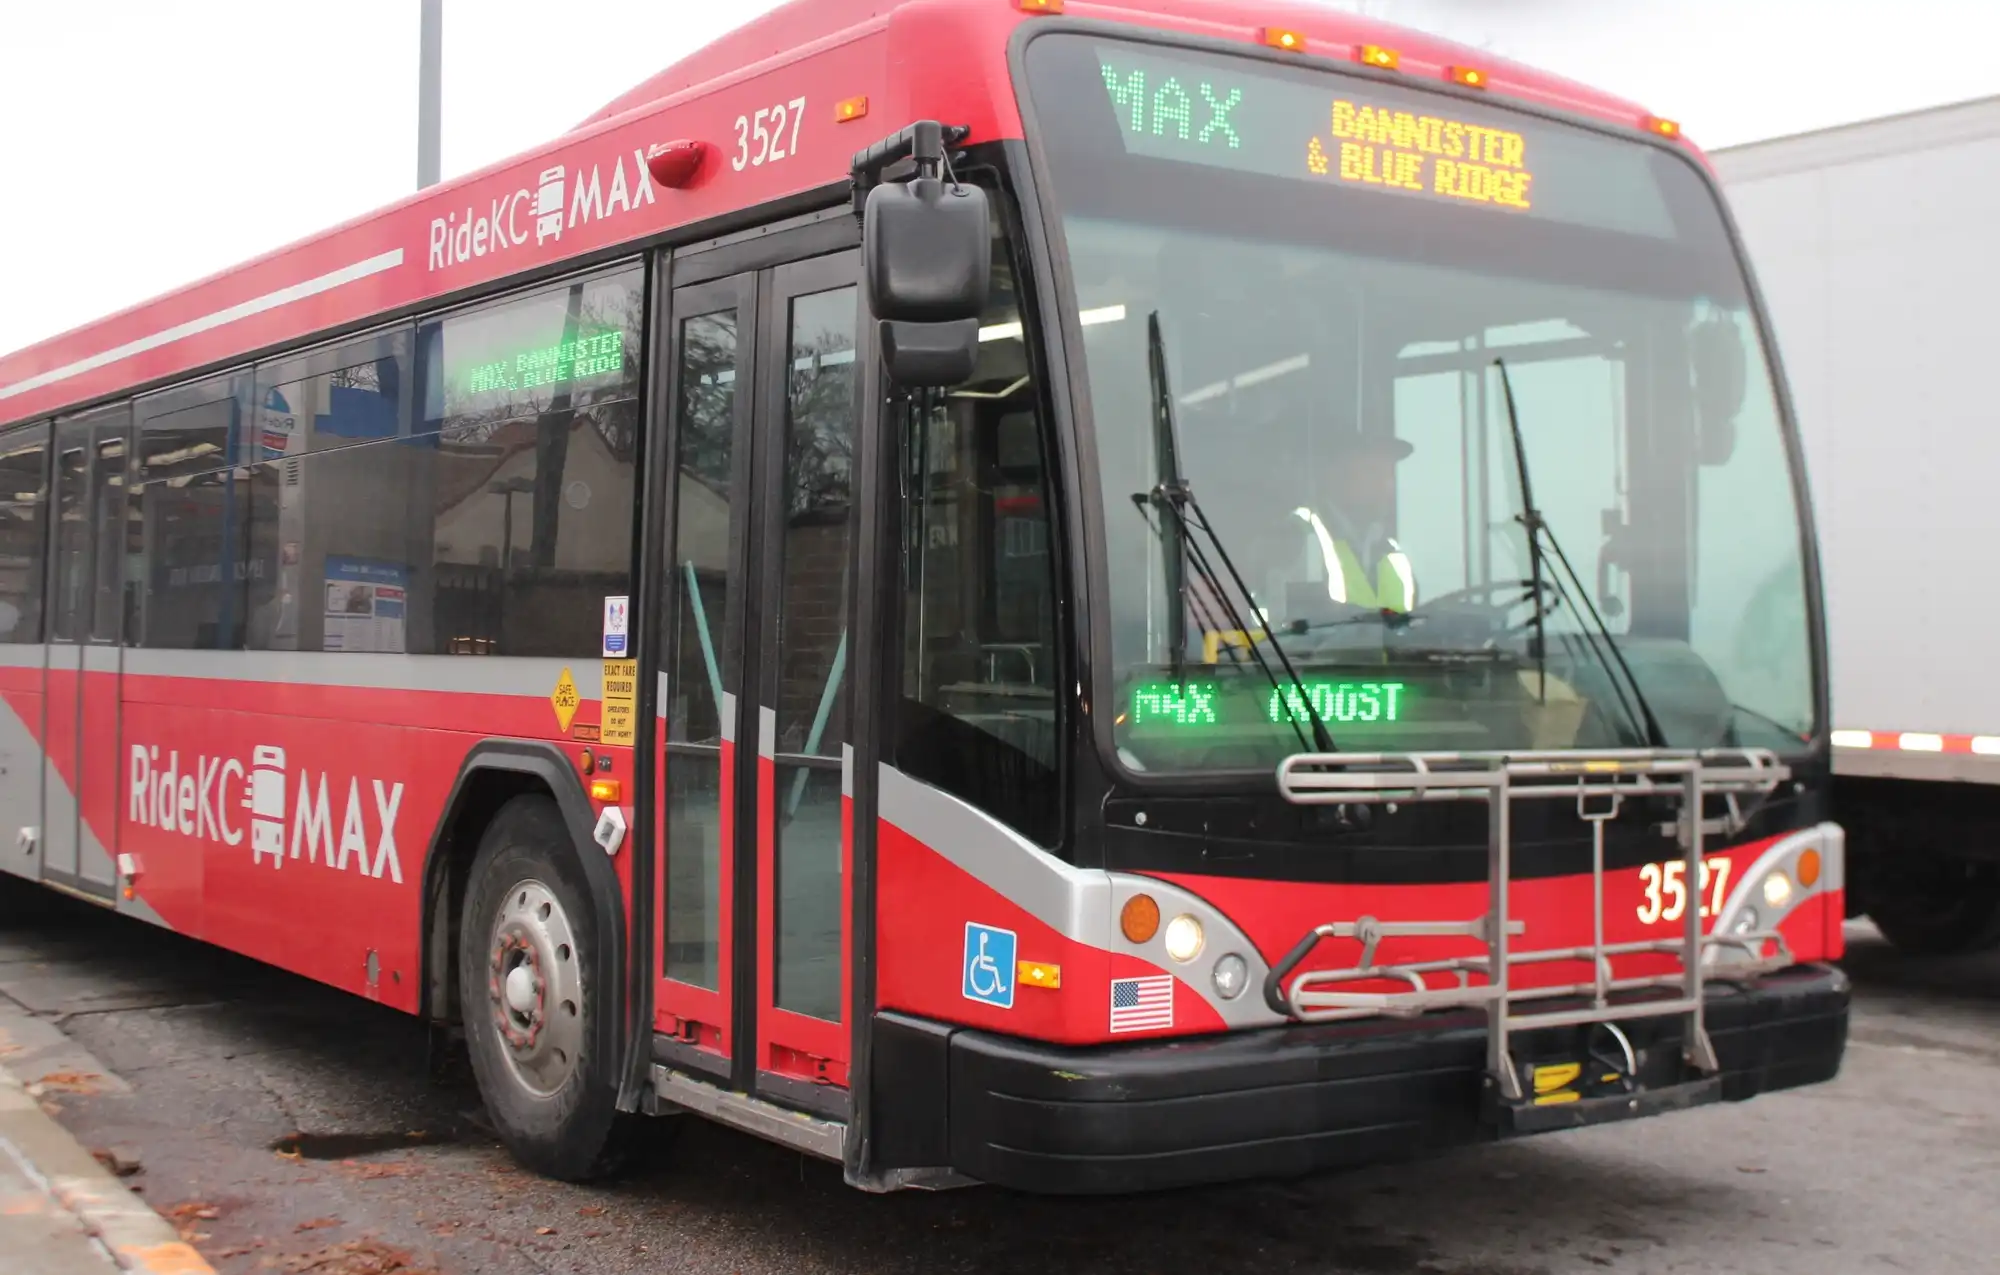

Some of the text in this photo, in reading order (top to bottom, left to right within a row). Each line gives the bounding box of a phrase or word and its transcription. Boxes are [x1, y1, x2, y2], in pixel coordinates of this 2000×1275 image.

[731, 96, 806, 172] 3527
[1332, 100, 1524, 168] BANNISTER
[1307, 136, 1531, 208] & BLUE RIDGE
[429, 143, 657, 272] RideKC MAX
[516, 331, 622, 373] BANNISTER
[524, 364, 568, 388] BLUE
[559, 684, 572, 695] SAFE
[604, 664, 636, 676] EXACT FARE
[606, 681, 632, 693] REQUIRED
[129, 744, 404, 884] RideKC MAX
